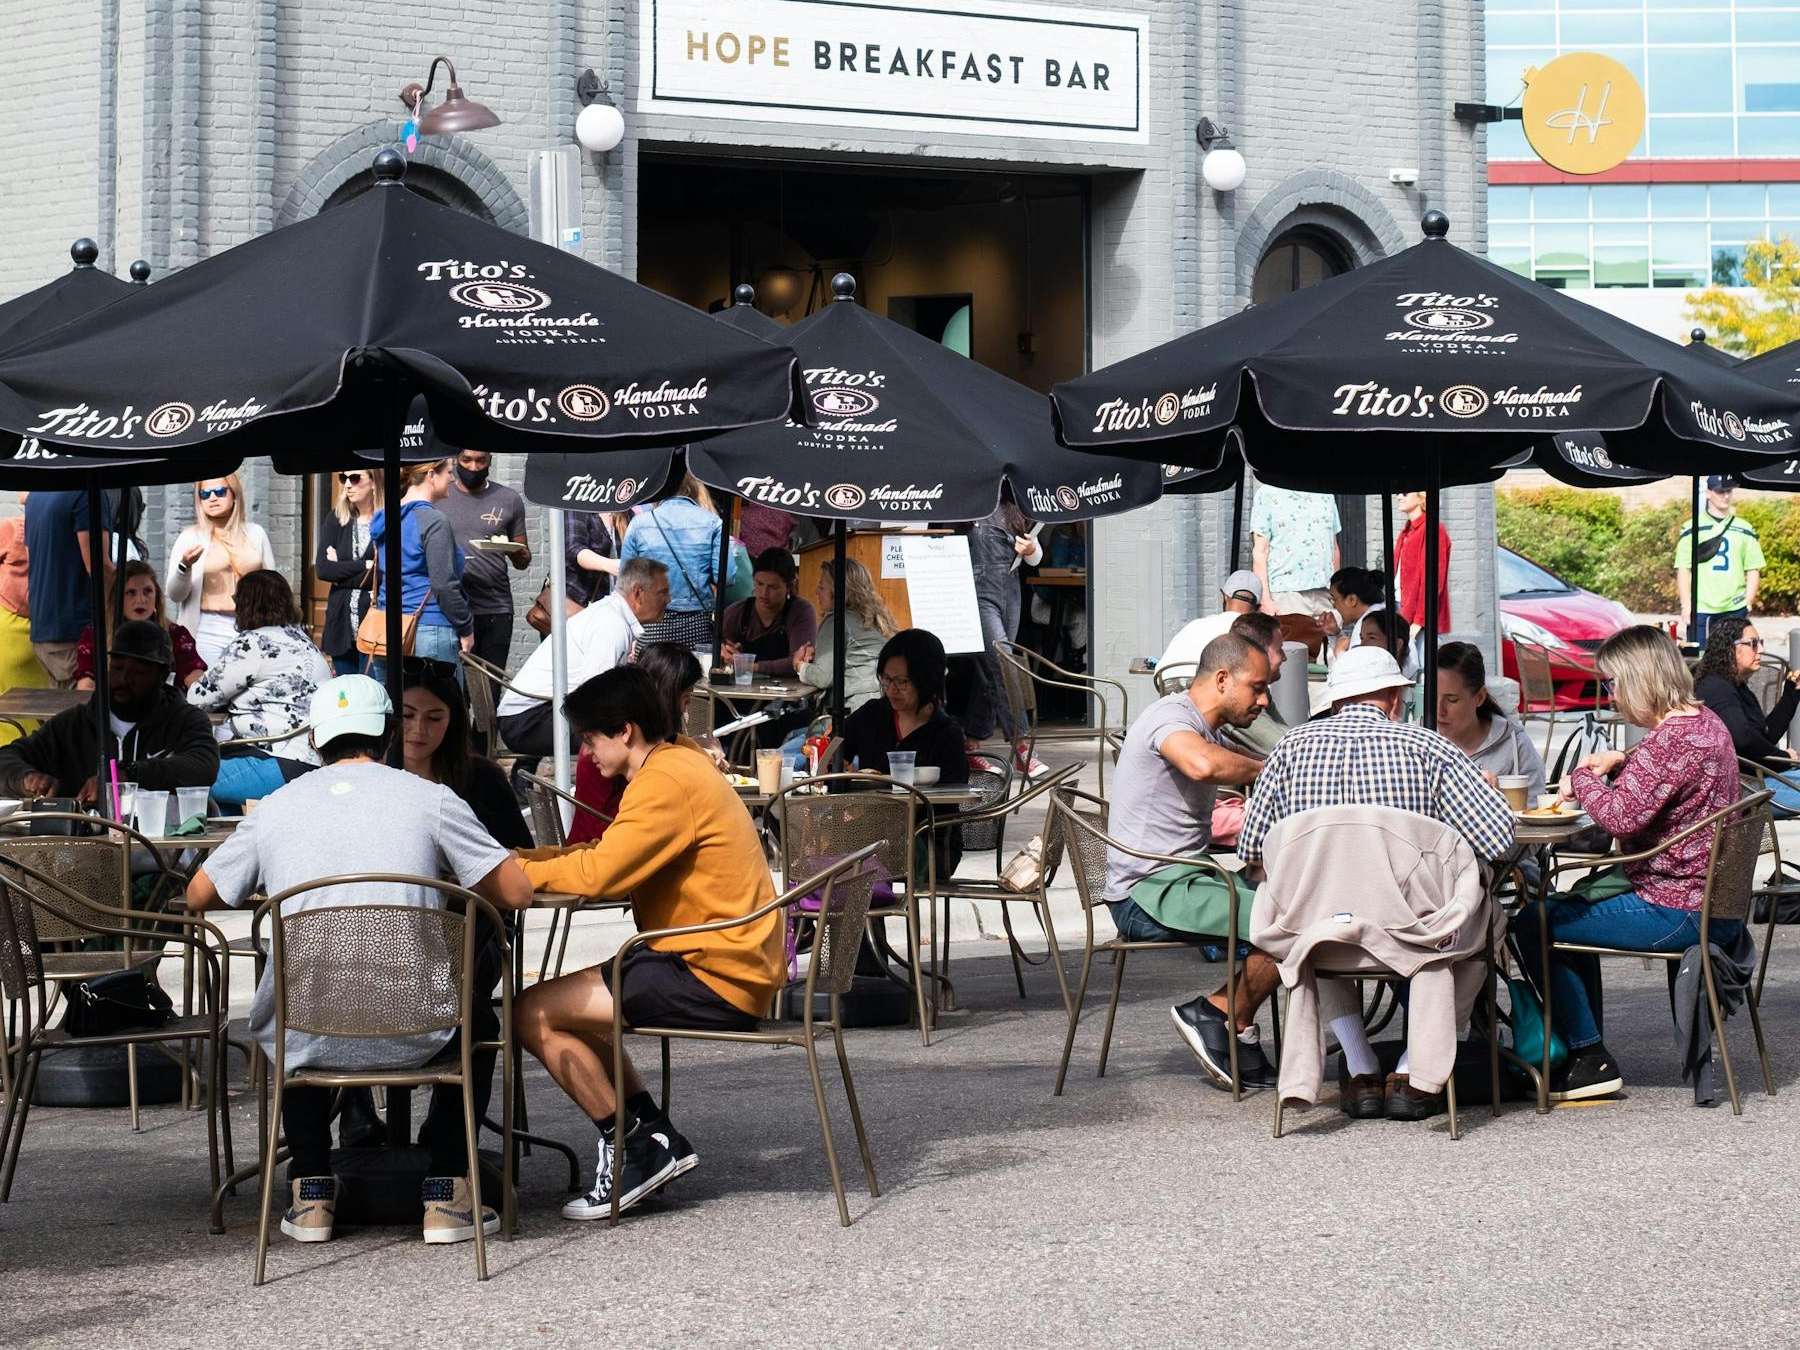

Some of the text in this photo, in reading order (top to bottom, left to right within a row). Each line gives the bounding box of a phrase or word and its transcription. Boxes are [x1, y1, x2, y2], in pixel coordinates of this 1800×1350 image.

[686, 29, 1110, 92] HOPE BREAKFAST BAR
[458, 313, 600, 328] Handmade
[503, 329, 580, 338] VODKA
[1384, 330, 1519, 343] Handmade
[561, 337, 606, 345] TEXAS
[1419, 342, 1487, 350] VODKA
[614, 377, 708, 407] Handmade
[1493, 384, 1583, 406] Handmade
[197, 396, 267, 422] Handm
[628, 403, 700, 420] VODKA
[1183, 404, 1211, 420] VODKA
[1505, 406, 1570, 418] VODKA
[207, 420, 242, 433] VOD
[813, 433, 868, 443] VODKA
[1752, 429, 1793, 443] VODKA
[797, 441, 832, 449] AUSTIN
[869, 483, 943, 501] Handmade
[1077, 473, 1122, 498] Handmade
[879, 500, 932, 511] VODKA
[1086, 491, 1121, 507] VODKA
